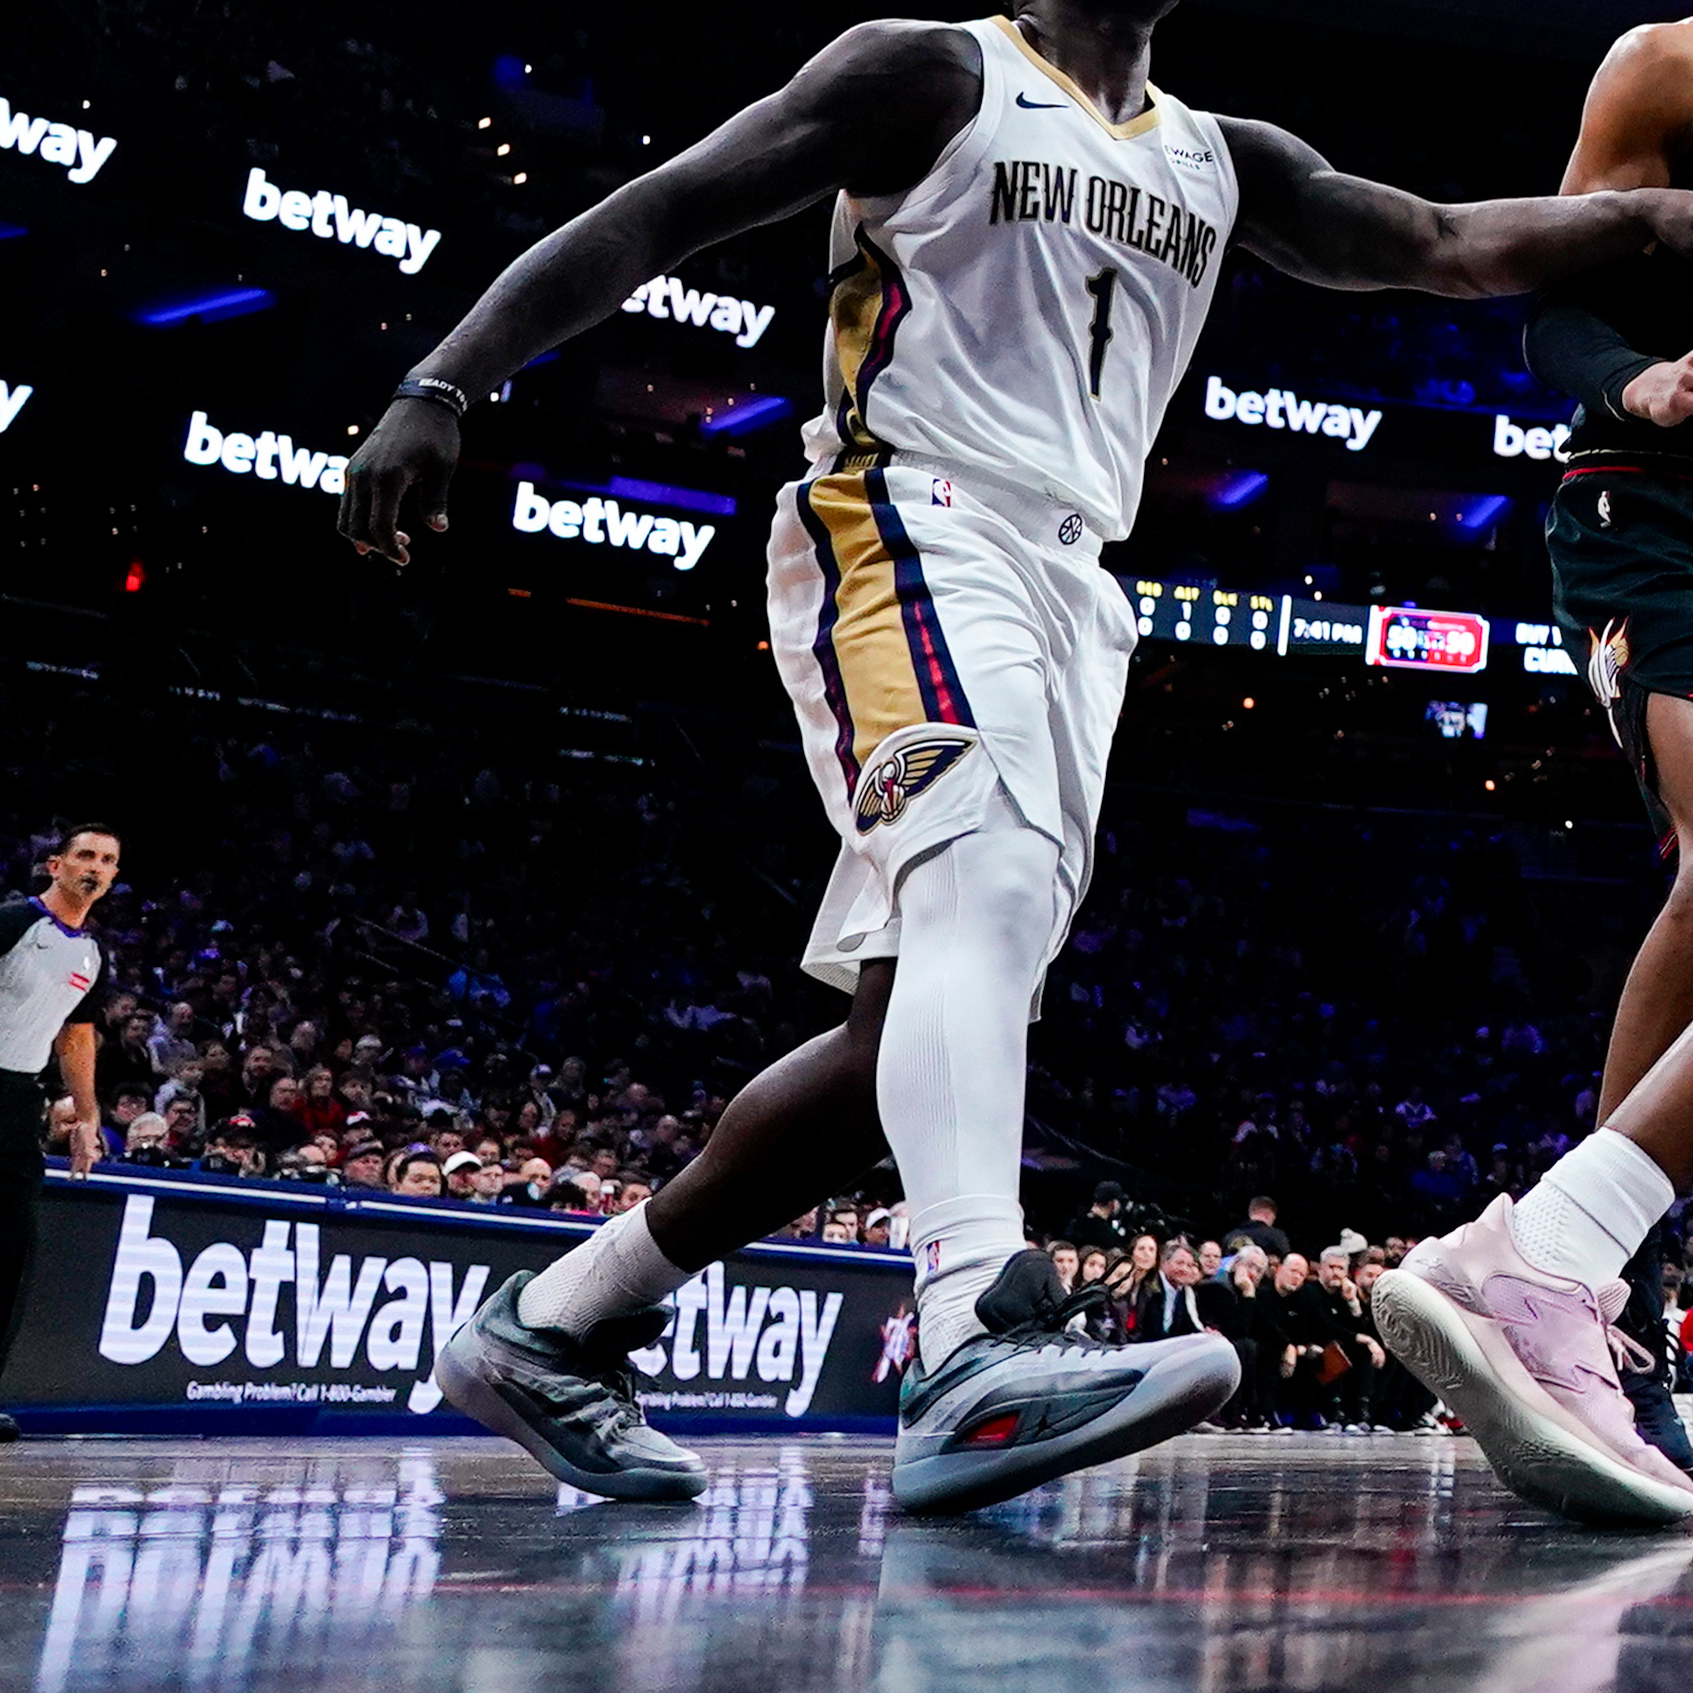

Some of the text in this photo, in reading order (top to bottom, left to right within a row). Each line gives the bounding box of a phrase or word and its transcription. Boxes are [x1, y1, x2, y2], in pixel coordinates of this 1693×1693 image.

[0, 98, 118, 184] way
[242, 167, 442, 275] betway
[989, 160, 1217, 289] NEW ORLEANS
[621, 274, 776, 349] etway
[1084, 267, 1120, 402] 1
[183, 410, 350, 495] betwa
[1204, 376, 1382, 451] betway
[1493, 414, 1572, 464] bet
[512, 481, 716, 571] betway
[98, 1193, 491, 1415] betway
[627, 1260, 844, 1418] tway
